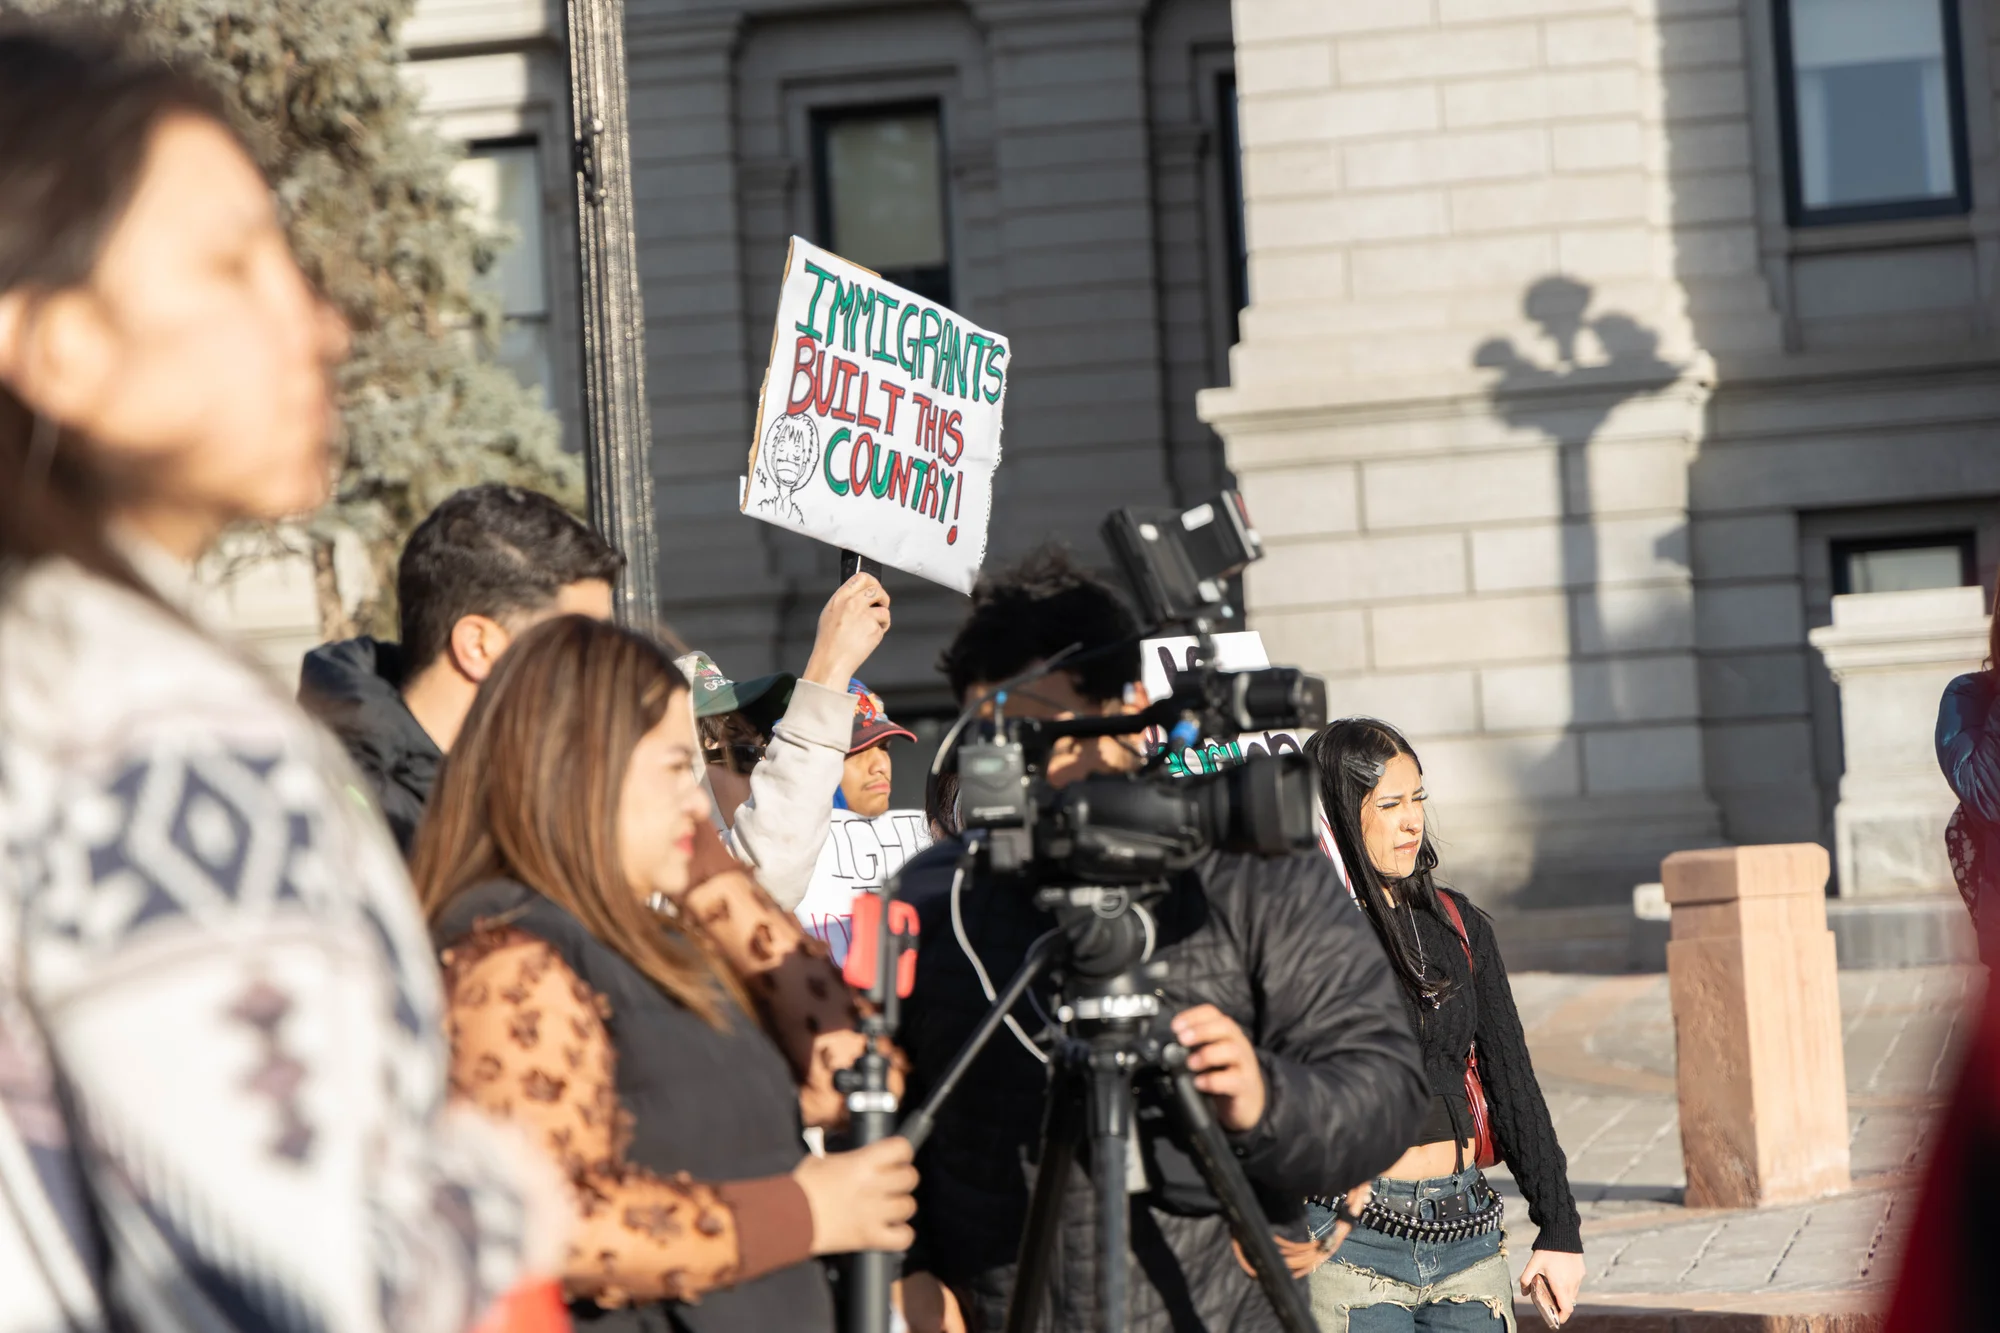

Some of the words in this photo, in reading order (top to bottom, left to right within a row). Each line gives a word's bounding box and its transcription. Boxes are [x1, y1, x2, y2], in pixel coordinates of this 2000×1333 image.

[795, 258, 1007, 405] IMMIGRANTS
[786, 335, 904, 436] BUILT
[912, 392, 964, 467] THIS
[823, 426, 964, 546] COUNTRY!
